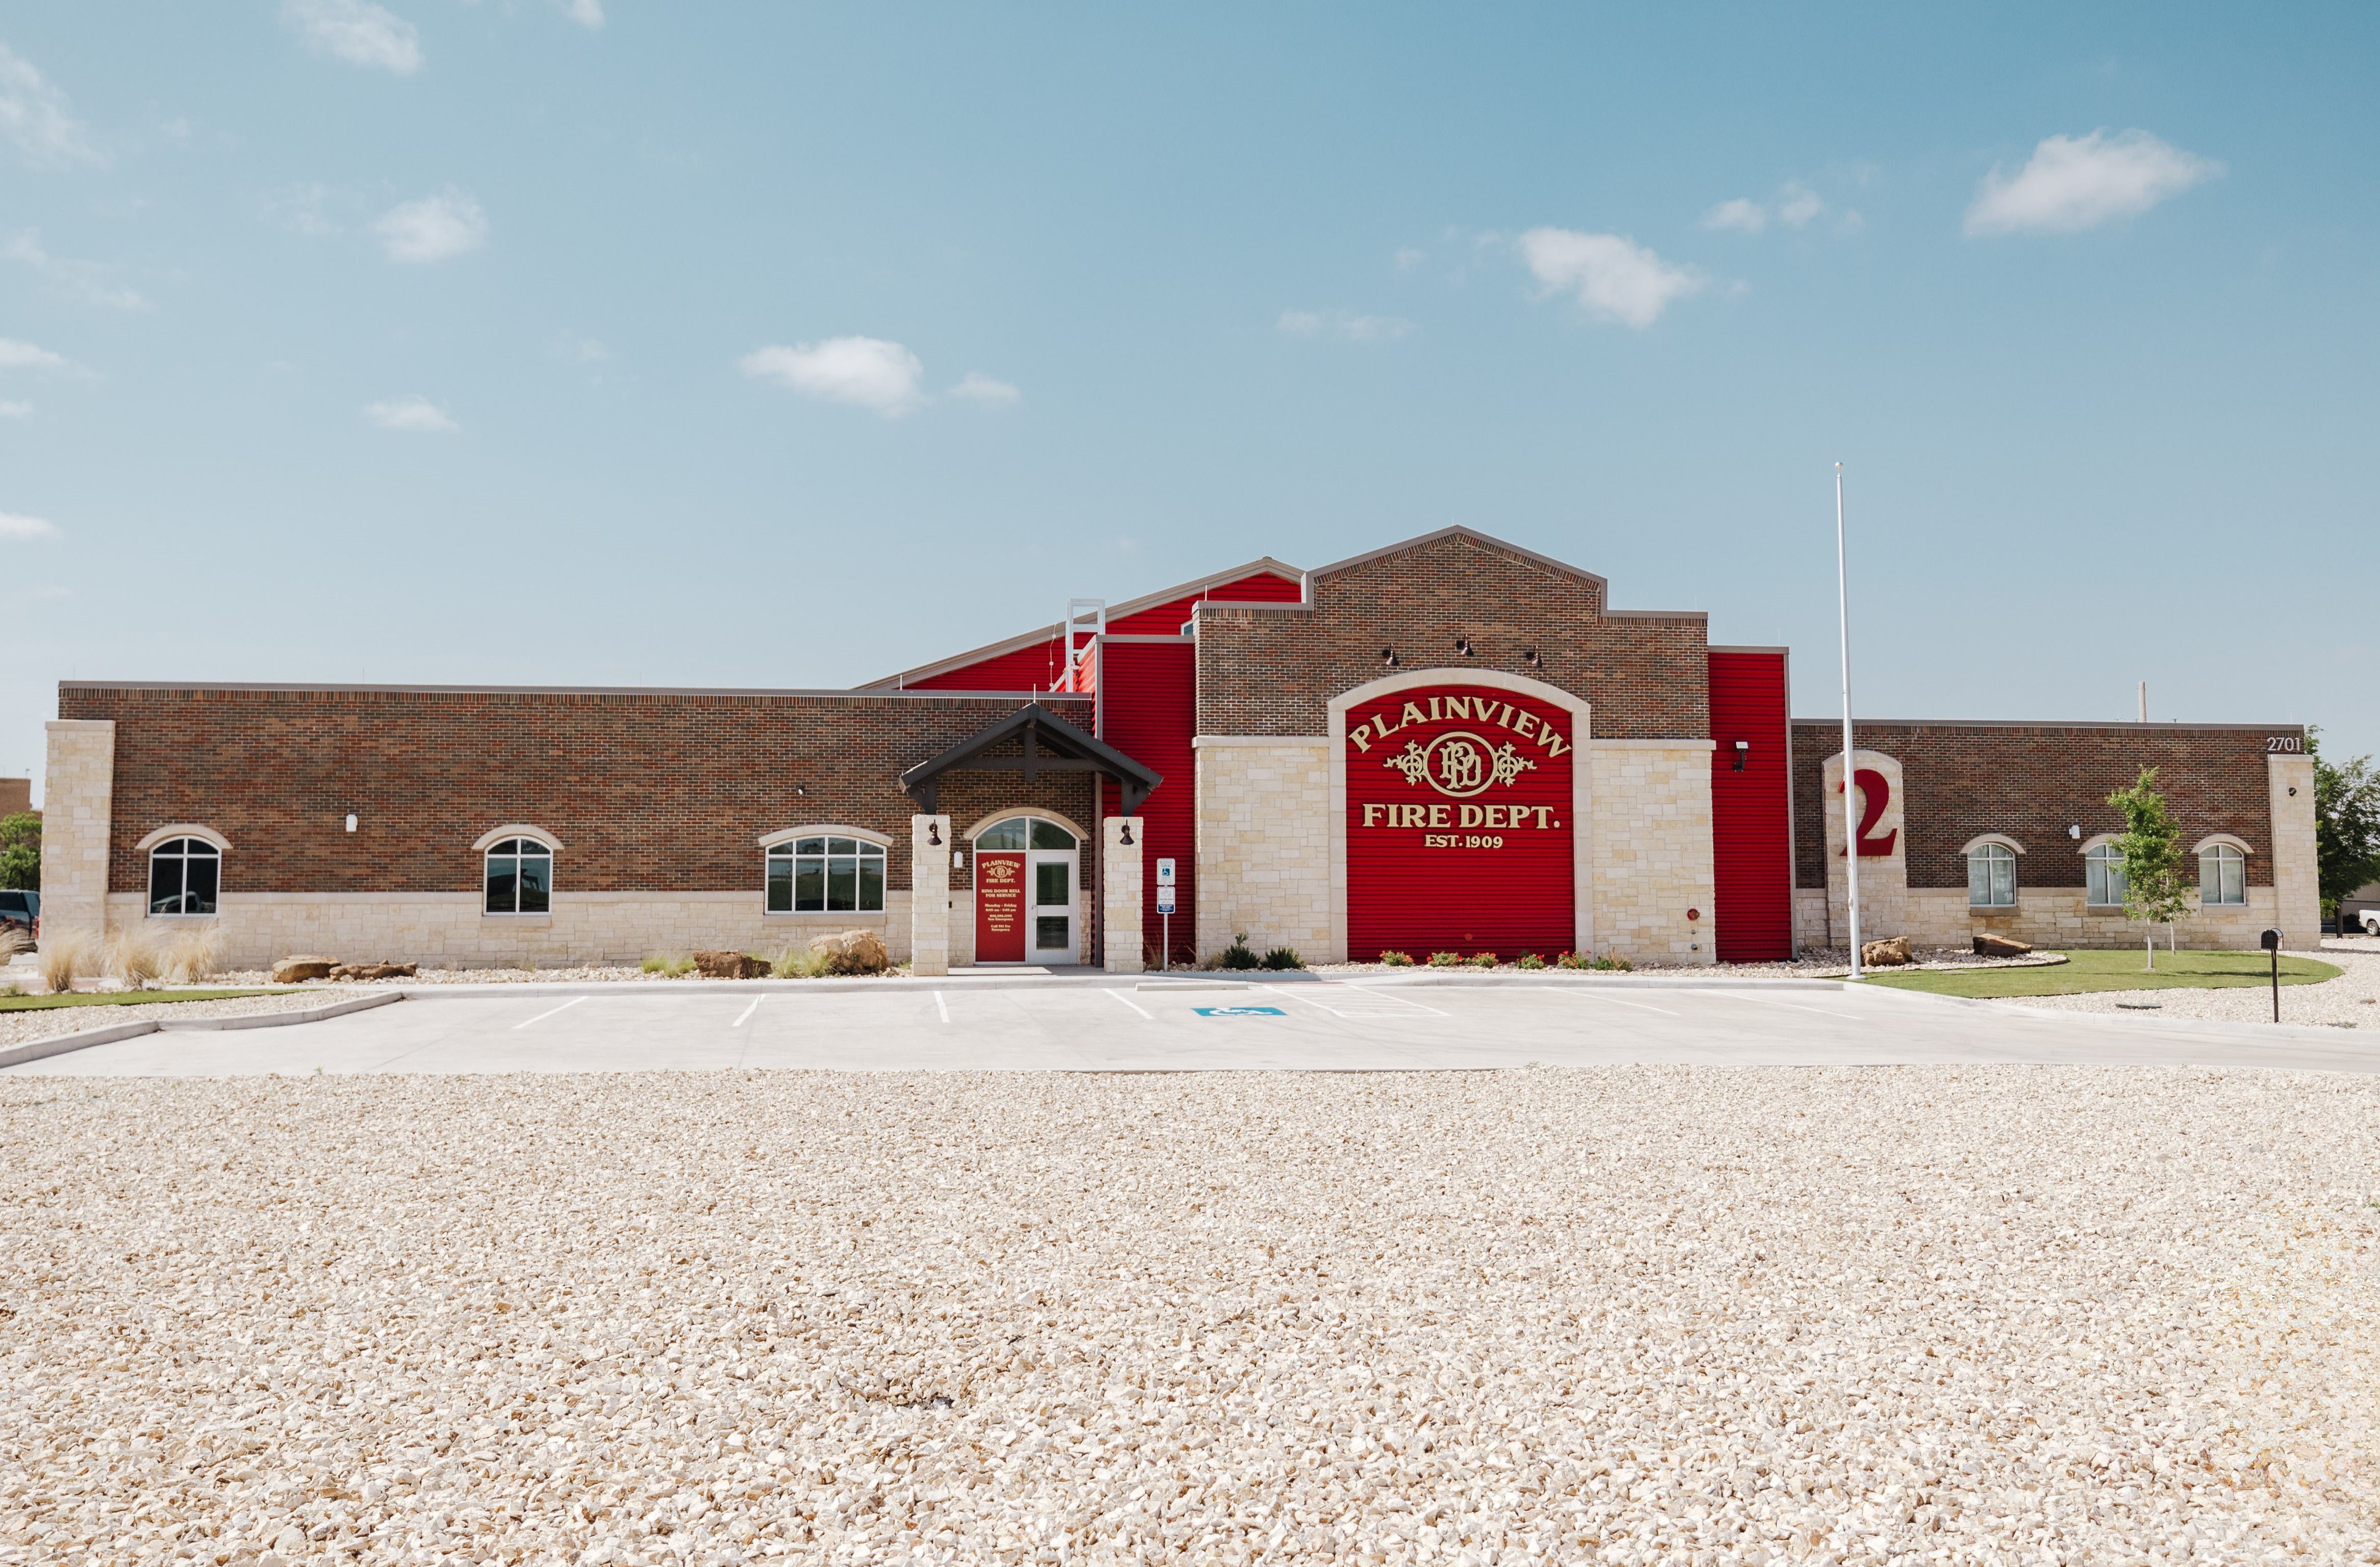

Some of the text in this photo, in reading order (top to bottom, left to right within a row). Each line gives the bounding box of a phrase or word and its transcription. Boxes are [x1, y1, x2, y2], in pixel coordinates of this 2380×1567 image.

[1349, 696, 1572, 758] PLAINVIEW
[2266, 737, 2300, 751] 2701
[1362, 803, 1560, 829] FIRE DEPT.
[1838, 769, 1897, 856] 2
[1424, 835, 1503, 849] EST. 1909
[982, 860, 1021, 868] PLAINVIEW
